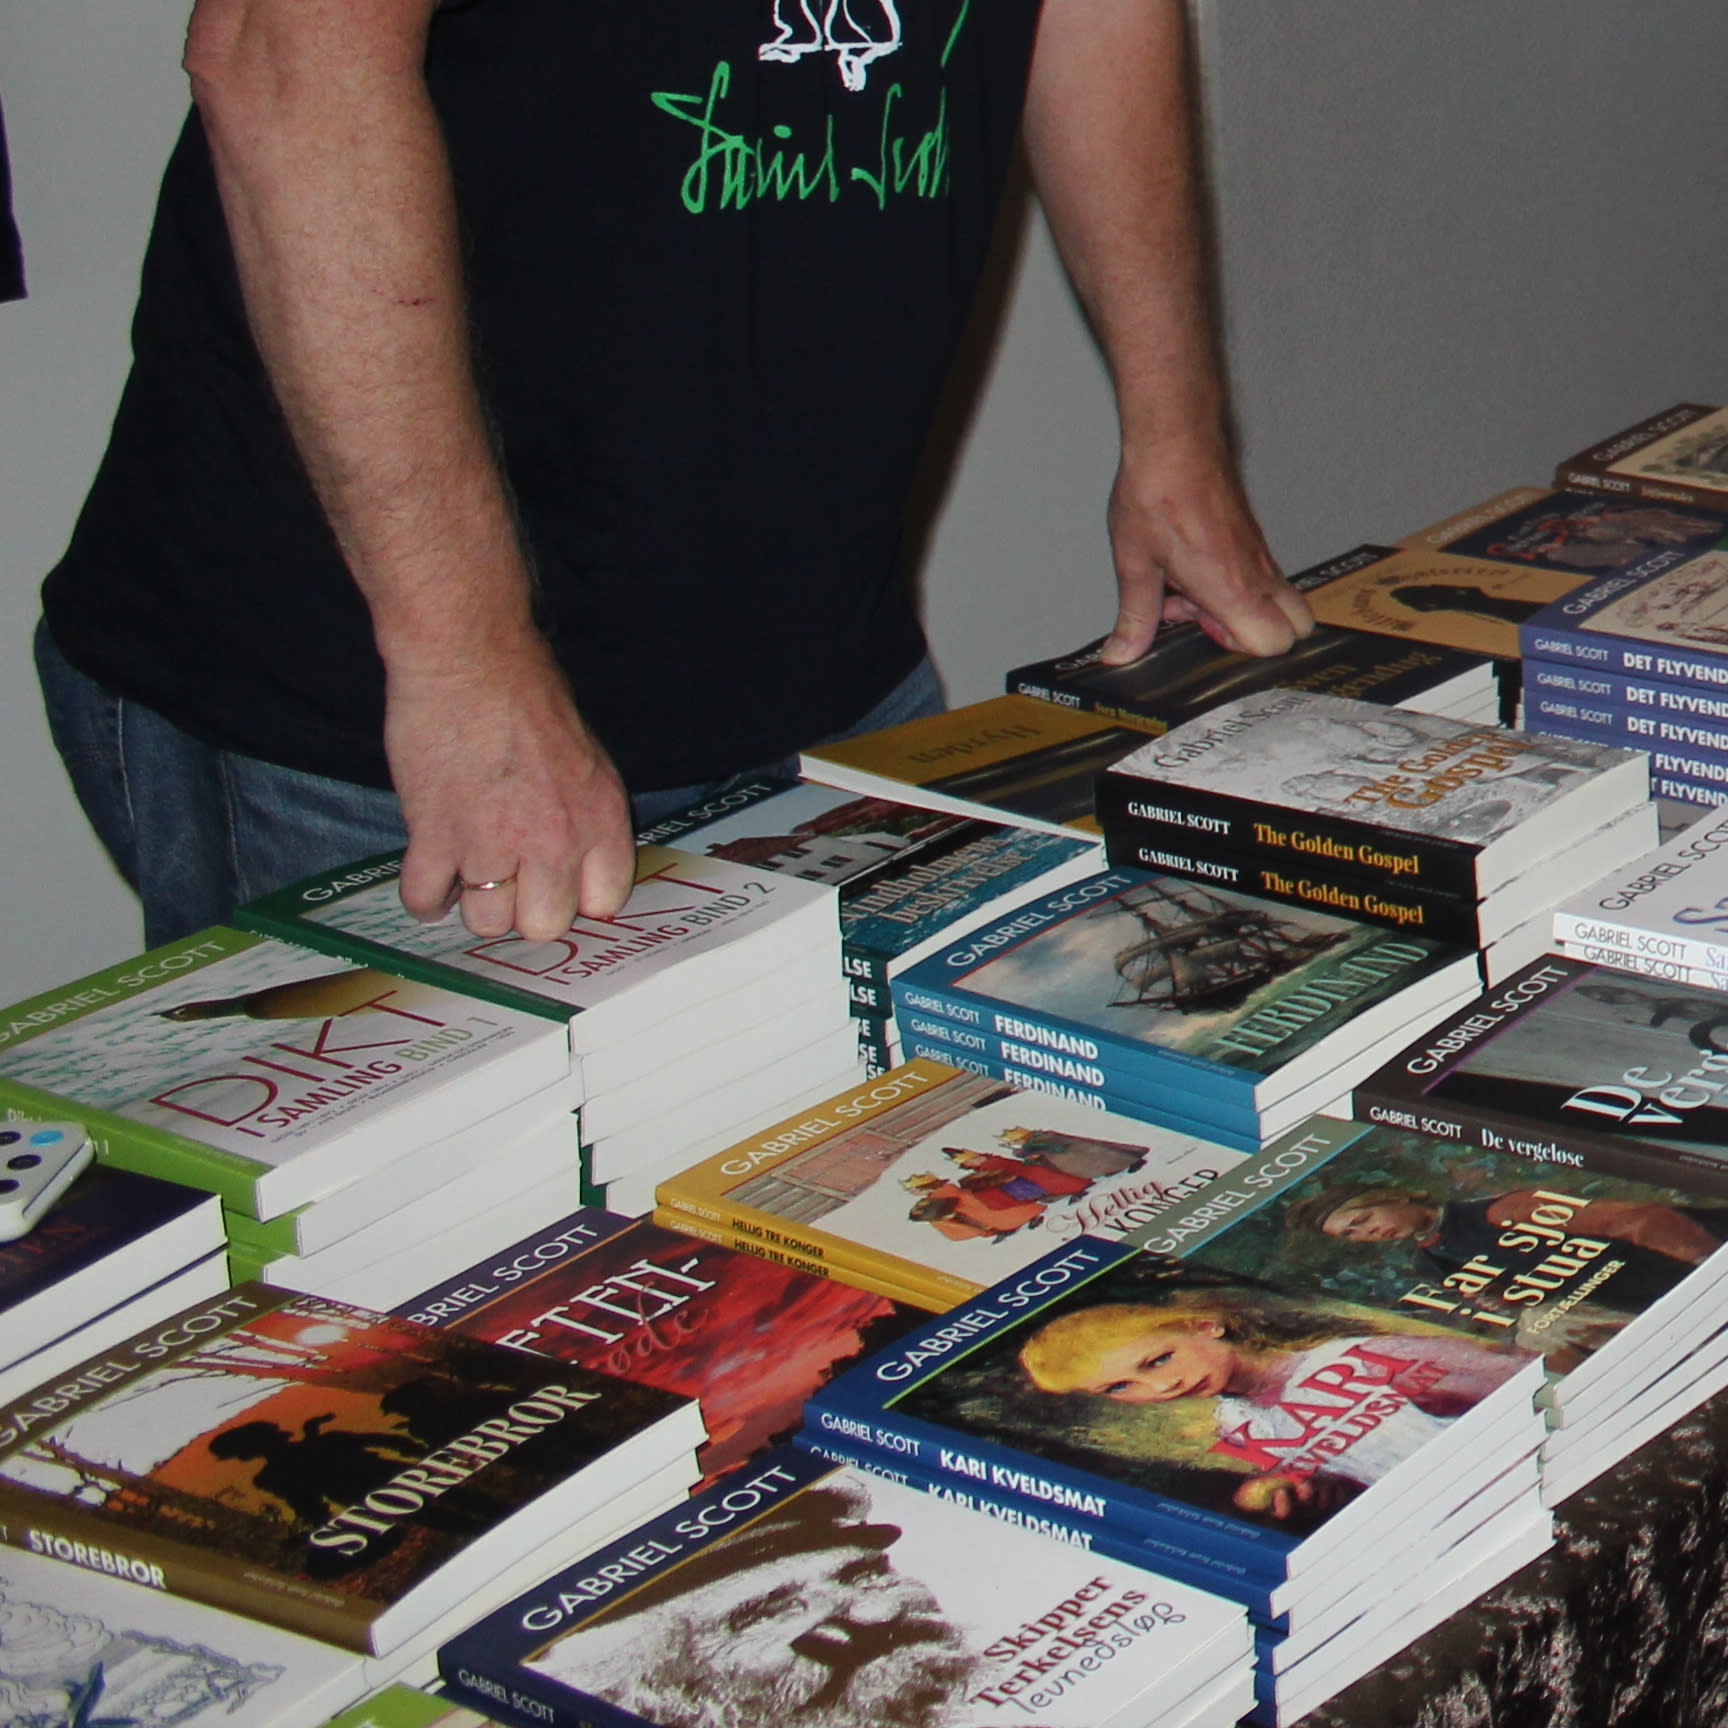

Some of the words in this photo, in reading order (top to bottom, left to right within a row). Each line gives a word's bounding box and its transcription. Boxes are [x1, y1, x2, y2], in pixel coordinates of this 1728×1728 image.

[1534, 637, 1573, 657] GABRIEL
[1574, 643, 1609, 662] SCOTT
[1623, 652, 1653, 672] DET
[1537, 672, 1575, 691] GABRIEL
[1577, 678, 1611, 697] SCOTT
[1626, 686, 1656, 707] DET
[1052, 689, 1081, 708] SCOTT
[1540, 701, 1577, 720] GABRIEL
[1578, 707, 1613, 726] SCOTT
[1627, 716, 1657, 736] DET
[1154, 716, 1255, 771] Gabriel
[1344, 772, 1405, 806] The
[1394, 729, 1498, 785] Golden
[1386, 734, 1536, 811] Gospel
[689, 783, 773, 819] SCOTT
[1127, 801, 1185, 826] GABRIEL
[1187, 812, 1231, 835] SCOTT
[1253, 822, 1287, 845] The
[1290, 829, 1355, 861] Golden
[1359, 843, 1419, 875] Gospel
[302, 848, 404, 903] GABRIE
[1138, 847, 1195, 872] GABRIEL
[1196, 858, 1240, 882] SCOTT
[1261, 870, 1295, 895] The
[1297, 878, 1360, 910] Golden
[1363, 891, 1424, 925] Gospel
[1599, 863, 1688, 913] GABRIEL
[568, 923, 689, 979] SAMLING
[684, 895, 750, 927] BIND
[945, 910, 1055, 969] GABRIEL
[1048, 873, 1133, 918] SCOTT
[1575, 923, 1635, 948] GABRIEL
[1637, 935, 1687, 961] SCOTT
[117, 940, 226, 990] SCOTT
[1583, 946, 1642, 971] GABRIEL
[904, 991, 943, 1014] GABRIEL
[945, 1001, 980, 1025] SCOTT
[994, 1015, 1099, 1060] FERDINAND
[1213, 940, 1429, 1058] FERDINAND
[1406, 1016, 1503, 1075] GABRIEL
[1499, 964, 1569, 1016] SCOTT
[150, 990, 446, 1128] DIKT
[258, 1059, 403, 1129] SAMLING
[397, 1026, 473, 1062] BIND
[911, 1019, 950, 1043] GABRIEL
[952, 1027, 987, 1051] SCOTT
[1000, 1041, 1104, 1087] FERDINAND
[1003, 1067, 1106, 1110] FERDINAND
[719, 1119, 842, 1176] GABRIEL
[836, 1071, 931, 1119] SCOTT
[1370, 1106, 1418, 1130] GABRIEL
[1420, 1115, 1462, 1140] SCOTT
[1481, 1126, 1503, 1150] De
[1560, 1065, 1675, 1122] De
[1046, 1180, 1163, 1235] Hellig
[1143, 1181, 1257, 1257] GABRIEL
[1251, 1133, 1331, 1190] SCOTT
[732, 1217, 763, 1238] HELLIG
[765, 1229, 781, 1243] TRE
[784, 1236, 825, 1258] KONGER
[734, 1239, 766, 1258] HELLIG
[768, 1250, 784, 1263] TRE
[787, 1256, 830, 1278] KONGER
[1400, 1253, 1508, 1315] Far
[1497, 1188, 1593, 1254] sjøl
[1502, 1235, 1612, 1308] stua
[407, 1282, 499, 1327] BRIEL
[493, 1223, 598, 1282] SCOTT
[1526, 1258, 1626, 1336] FORTÆLLINGER
[145, 1295, 259, 1357] SCOTT
[875, 1305, 1008, 1385] GABRIEL
[997, 1247, 1101, 1311] SCOTT
[1209, 1340, 1419, 1472] KARI
[310, 1384, 602, 1557] STOREBROR
[821, 1411, 872, 1442] GABRIEL
[874, 1428, 921, 1457] SCOTT
[940, 1448, 987, 1480] KARI
[992, 1463, 1106, 1518] KVELDSMAT
[30, 1530, 167, 1589] STOREBROR
[522, 1540, 682, 1632] GABRIEL
[675, 1465, 796, 1541] SCOTT
[978, 1497, 1093, 1551] KVELDSMAT
[969, 1588, 1149, 1709] Terkelsens
[984, 1575, 1115, 1663] Skipper
[1006, 1601, 1187, 1715] levnedsløp
[458, 1669, 510, 1705] GABRIEL
[511, 1690, 555, 1724] SCOTT
